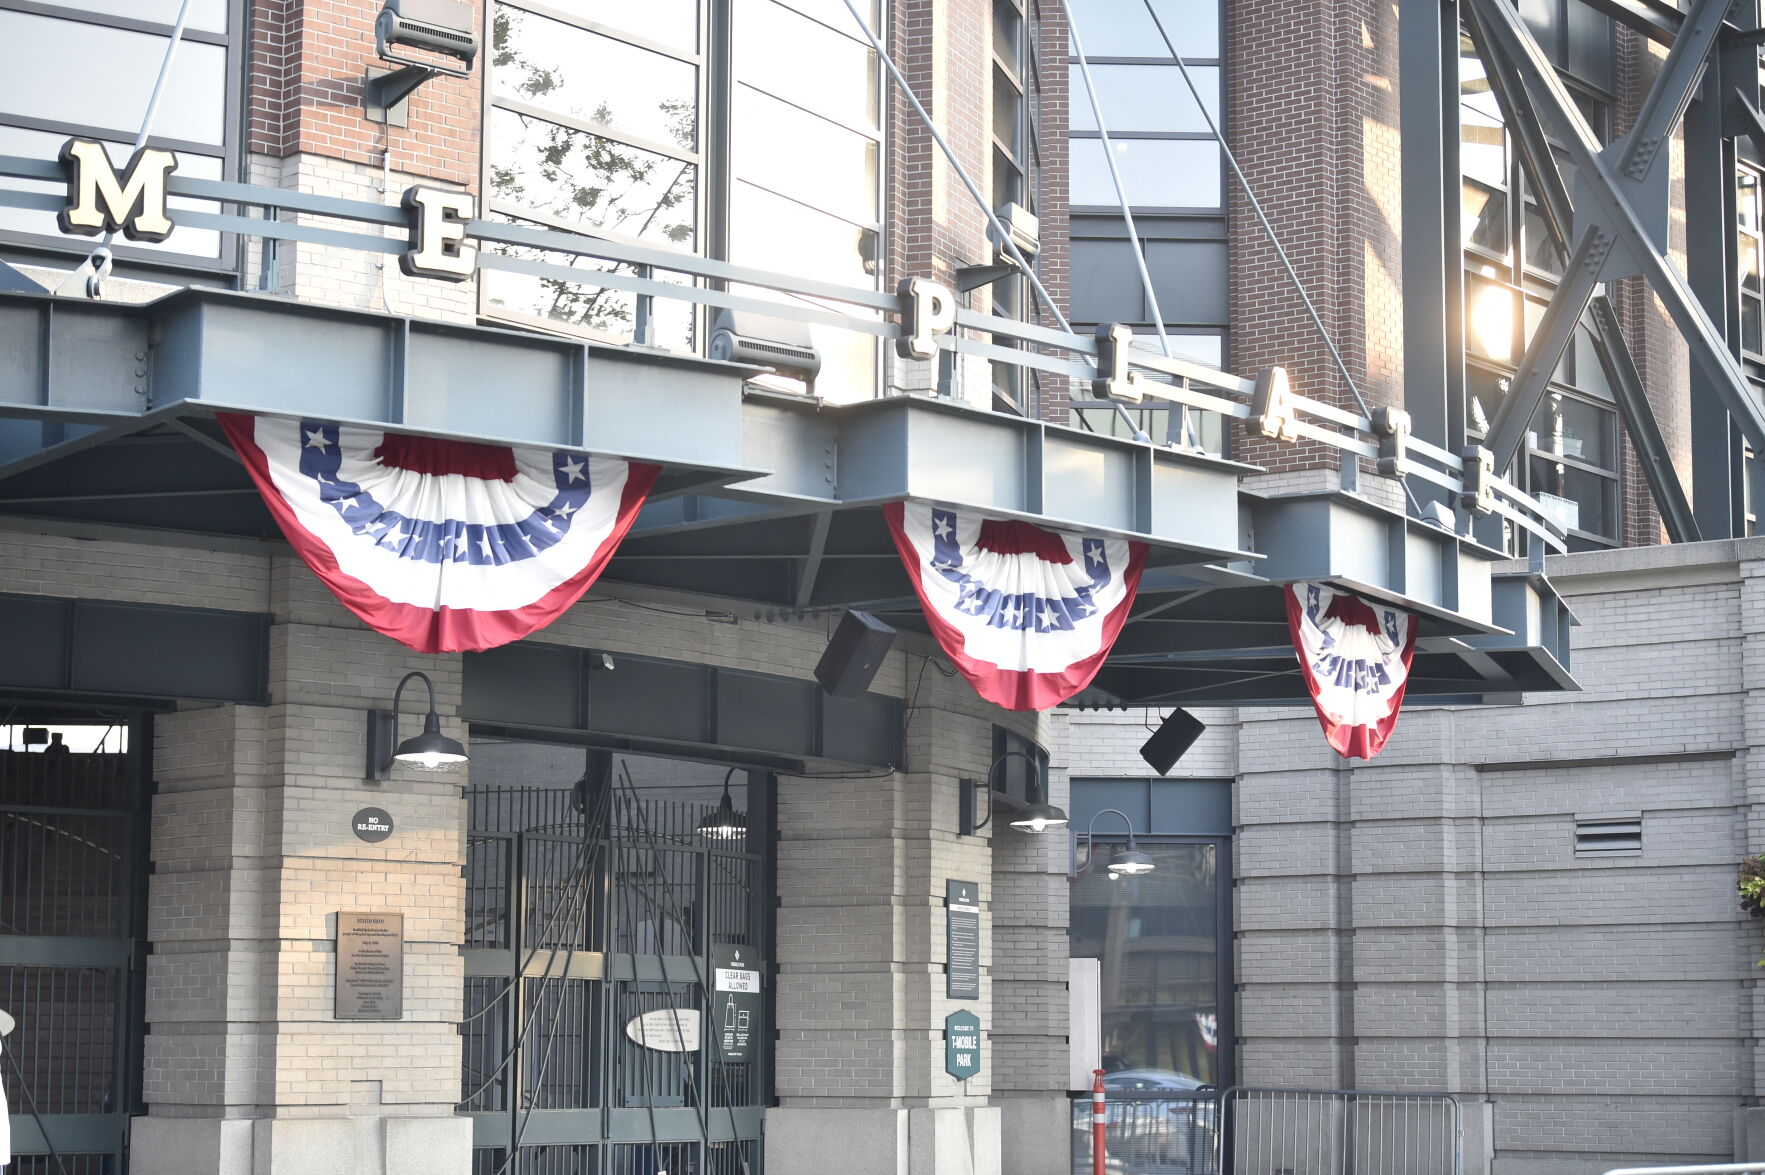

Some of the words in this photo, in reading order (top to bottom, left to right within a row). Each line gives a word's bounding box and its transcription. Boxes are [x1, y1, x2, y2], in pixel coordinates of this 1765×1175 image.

[58, 137, 478, 281] ME
[896, 276, 1495, 516] PLATE
[357, 823, 390, 832] RE-ENTRY
[725, 971, 739, 980] CLEAR
[739, 971, 751, 981] BAGS
[728, 981, 749, 991] ALLOWED
[951, 1035, 977, 1049] T-MOBILE
[956, 1053, 972, 1067] PARK
